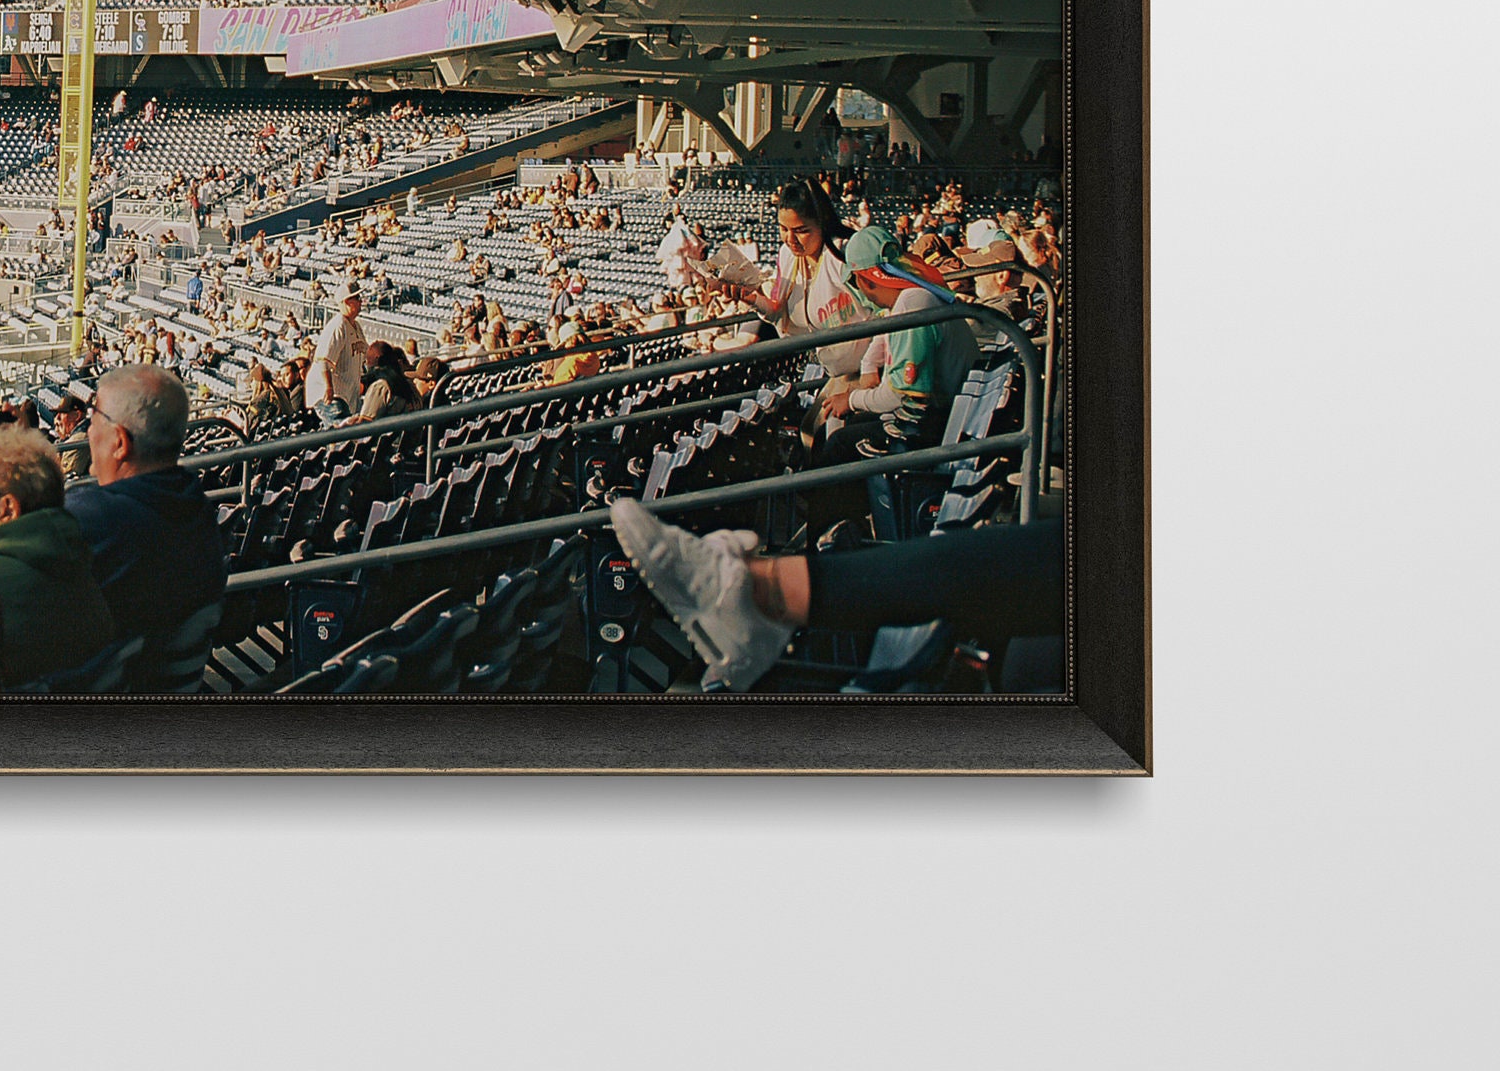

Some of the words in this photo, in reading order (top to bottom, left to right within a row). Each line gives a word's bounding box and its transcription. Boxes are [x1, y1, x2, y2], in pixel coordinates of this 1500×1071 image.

[29, 13, 53, 26] SENGA
[94, 12, 119, 25] STEELE
[157, 11, 190, 24] GOMBER
[28, 25, 52, 41] 6:40
[95, 25, 116, 41] 7:10
[162, 25, 184, 40] 7:10
[213, 8, 276, 54] SAN
[135, 34, 144, 52] S
[609, 560, 631, 568] petco
[605, 627, 619, 638] 38
